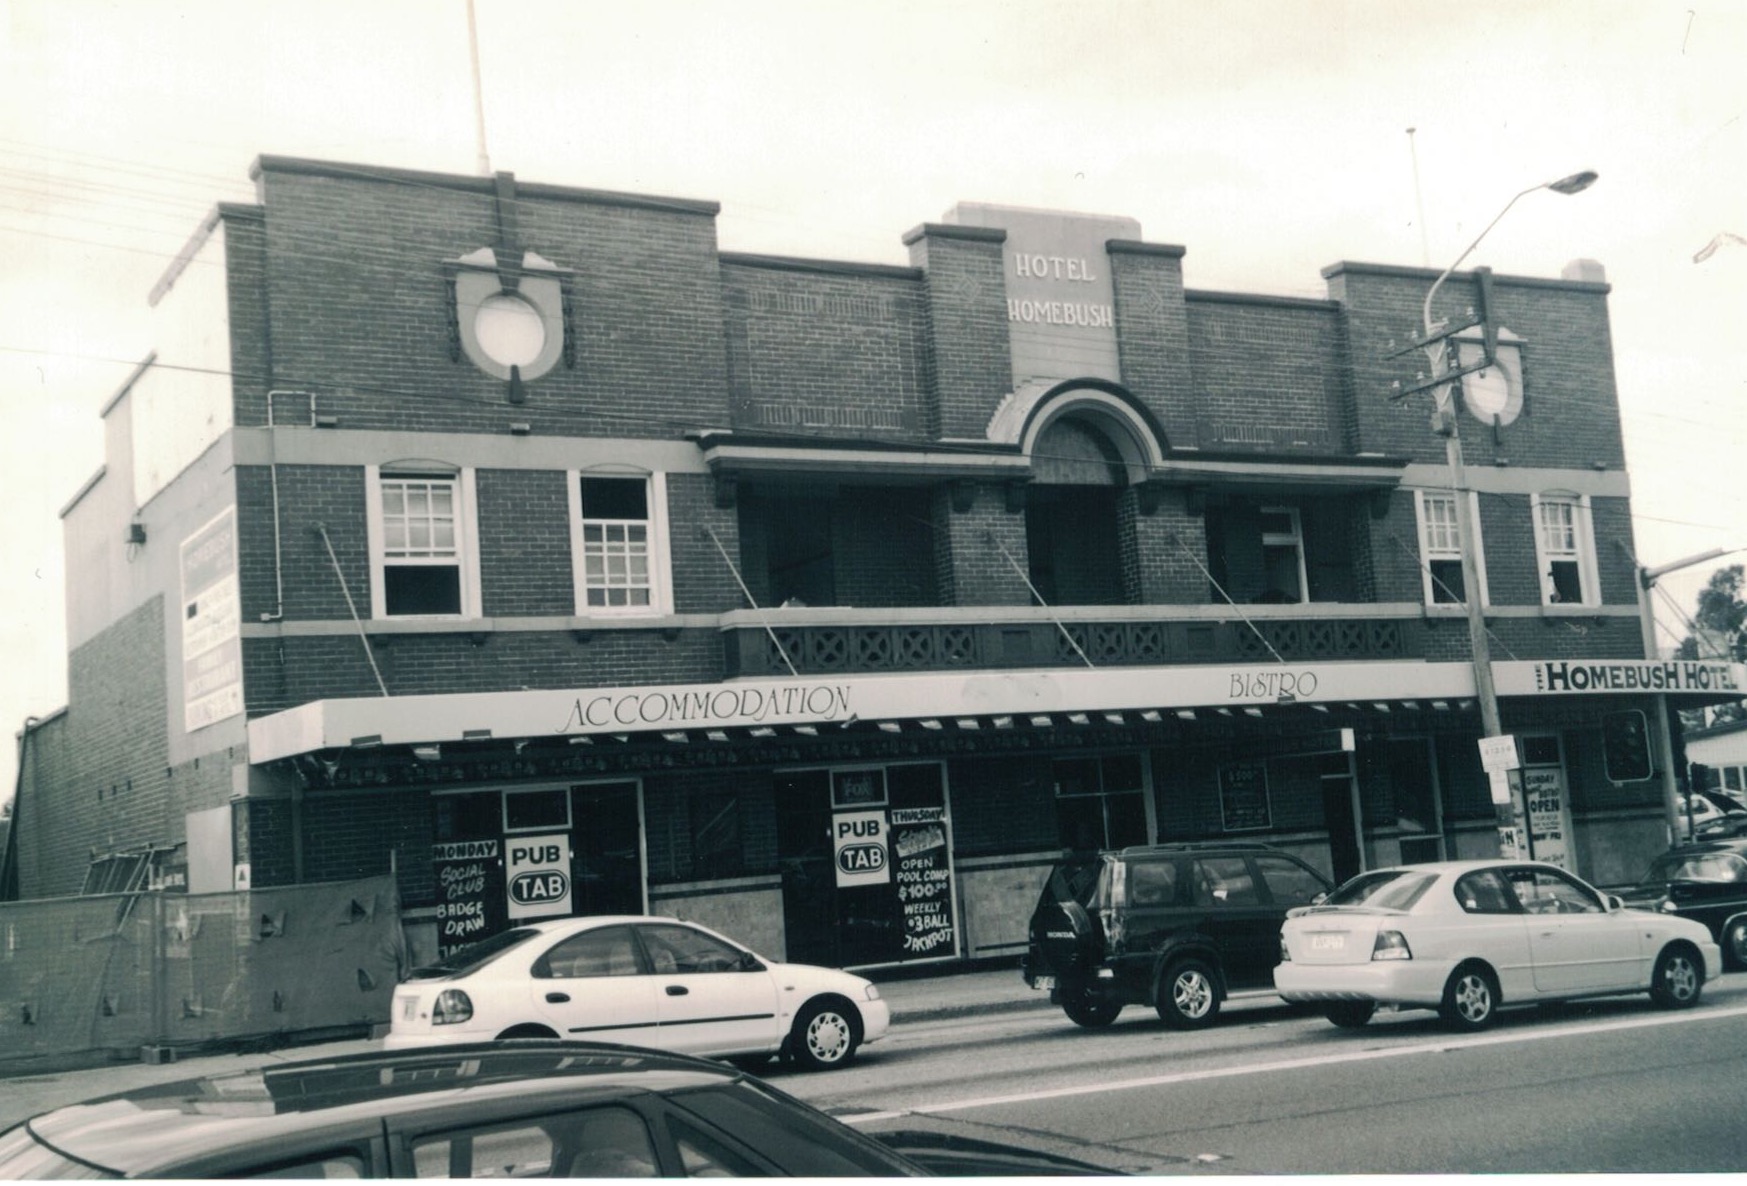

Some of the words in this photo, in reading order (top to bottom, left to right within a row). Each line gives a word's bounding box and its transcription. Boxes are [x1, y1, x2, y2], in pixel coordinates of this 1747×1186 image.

[1015, 253, 1096, 281] HOTEL
[1007, 298, 1113, 328] HOMEBUSH
[1229, 671, 1318, 698] BISTRO
[1684, 663, 1738, 690] HOTEL
[555, 686, 851, 733] ACCOMMODATION
[893, 810, 943, 823] THURSDAY
[1530, 800, 1560, 813] OPEN
[838, 820, 880, 838] PUB
[433, 842, 496, 859] MONDAY
[512, 845, 560, 866] PUB
[843, 850, 882, 869] TAB
[441, 862, 486, 886] SOCIAL
[901, 857, 933, 870] OPEN
[897, 872, 922, 882] POOL
[924, 870, 949, 881] COMP
[446, 877, 484, 899] CLUB
[518, 876, 563, 899] TAB
[437, 901, 484, 918] BADGE
[904, 901, 941, 915] WEEKLY
[445, 914, 485, 936] DRAW
[903, 928, 953, 952] JACKPOT
